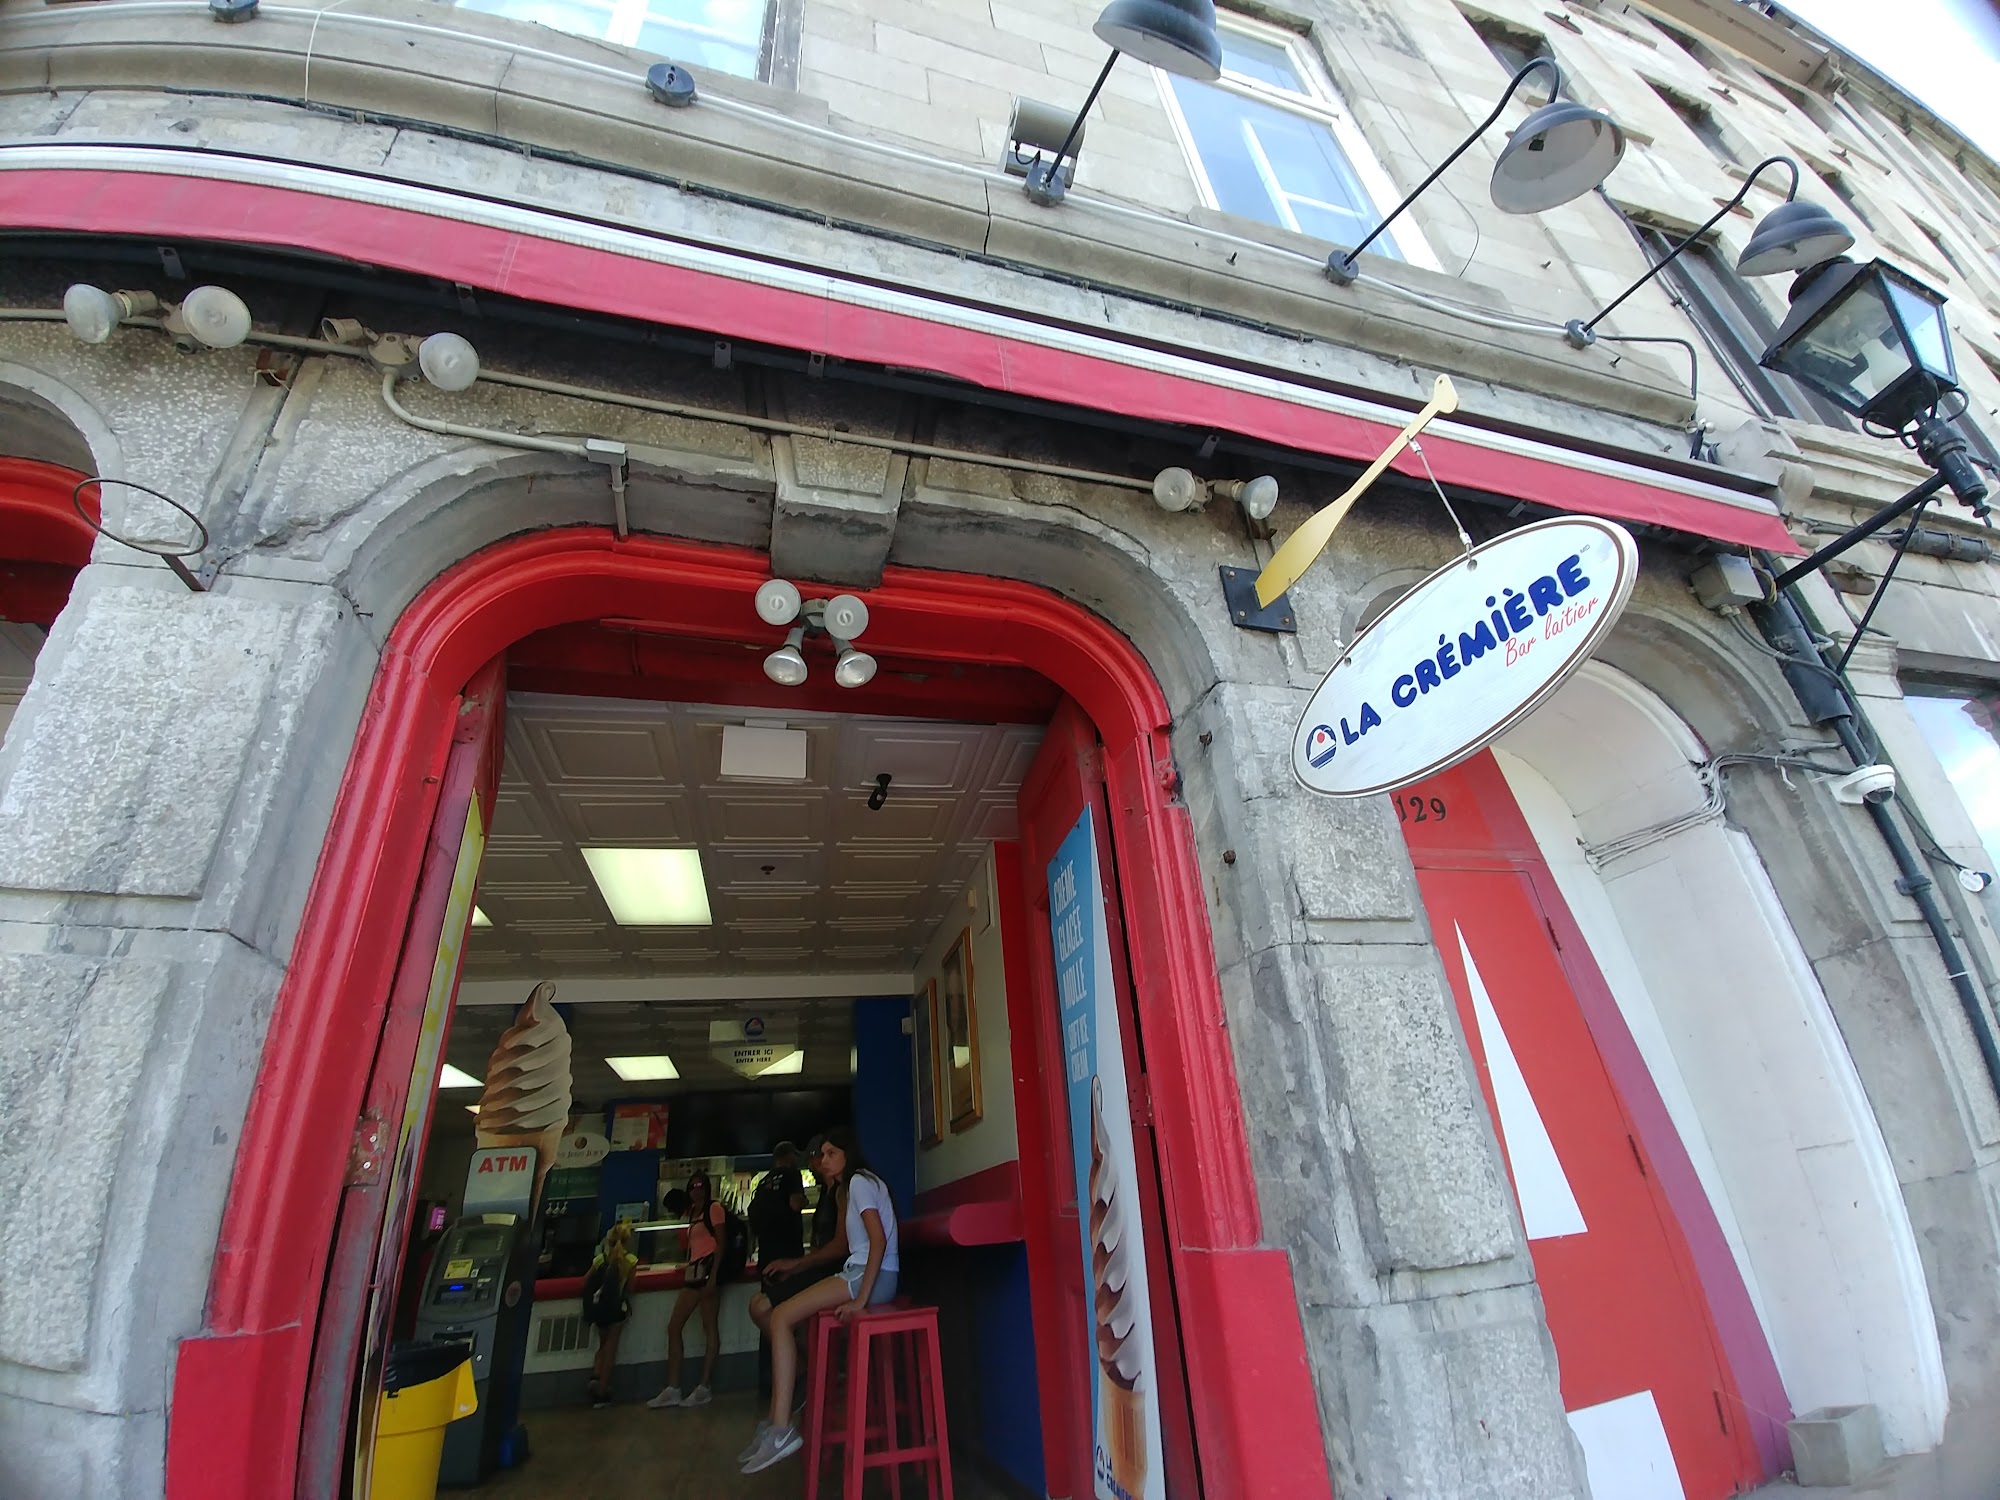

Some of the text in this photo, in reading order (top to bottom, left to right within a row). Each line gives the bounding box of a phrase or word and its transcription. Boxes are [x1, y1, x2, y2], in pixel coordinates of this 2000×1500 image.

[1340, 554, 1591, 746] LA CRÉMIÈRE
[1505, 597, 1599, 668] Bar laitier
[1396, 795, 1446, 823] 129
[1058, 900, 1084, 963] GLACÉE
[1062, 956, 1087, 1010] MOLLE
[734, 1049, 760, 1057] ENTRER
[478, 1155, 528, 1173] ATM
